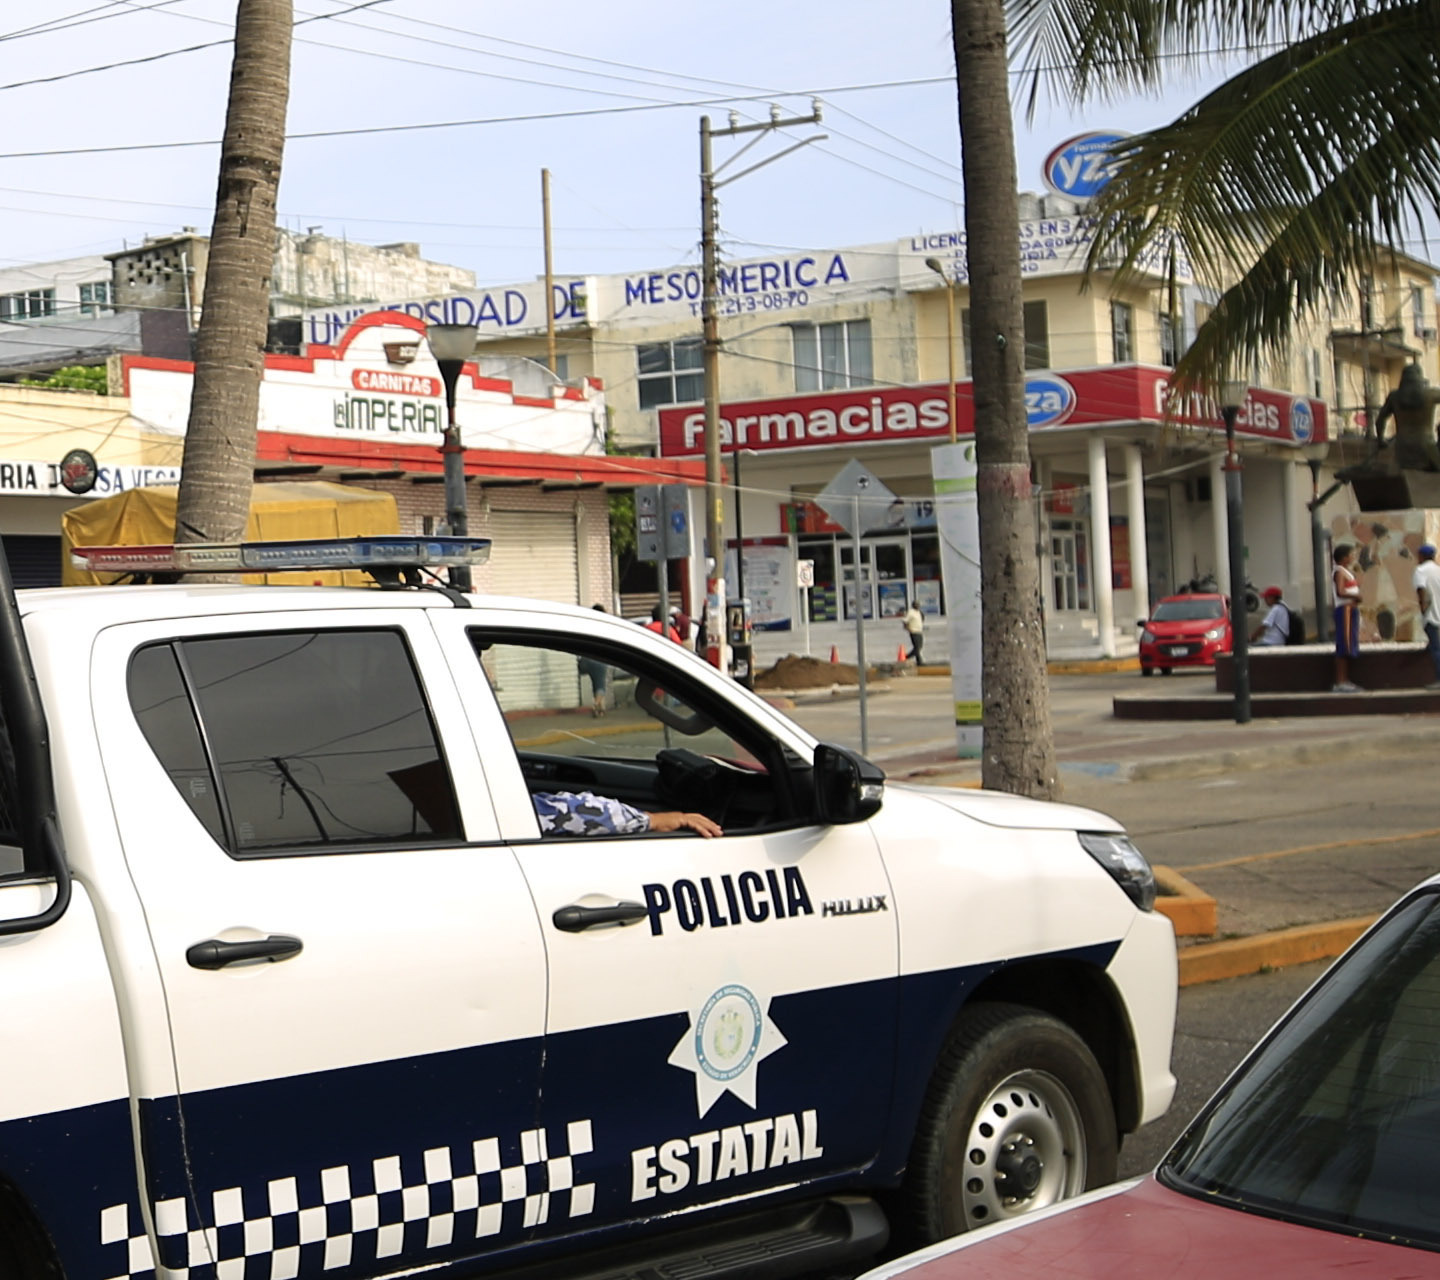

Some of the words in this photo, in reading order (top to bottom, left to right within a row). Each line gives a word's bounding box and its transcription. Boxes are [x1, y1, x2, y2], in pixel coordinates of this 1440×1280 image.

[310, 290, 528, 345] UNRSIDAD
[553, 281, 586, 319] DE
[358, 370, 432, 395] CARNITAS
[683, 396, 949, 450] farmacias
[1024, 390, 1062, 413] za
[642, 866, 815, 937] POLICIA
[631, 1110, 824, 1203] ESTATAL
